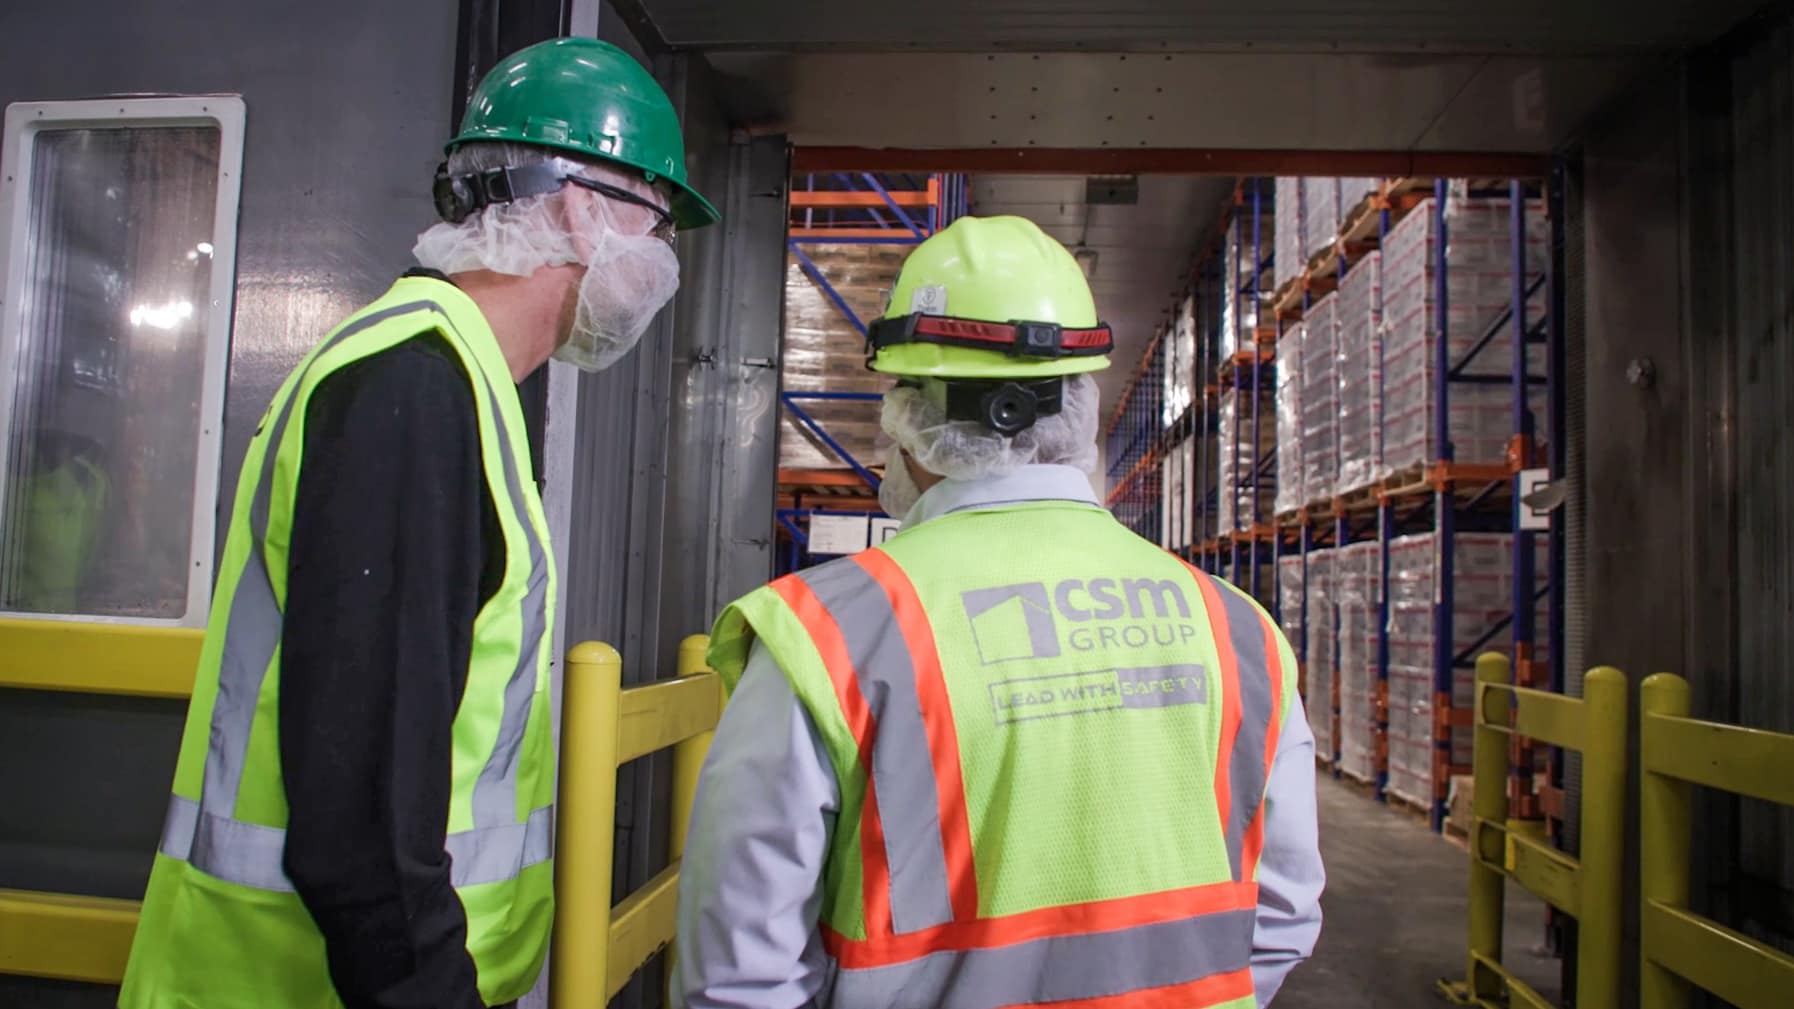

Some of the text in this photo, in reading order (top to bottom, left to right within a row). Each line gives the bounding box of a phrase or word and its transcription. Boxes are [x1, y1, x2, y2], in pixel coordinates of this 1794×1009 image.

[1054, 577, 1192, 622] csm
[1069, 624, 1196, 651] GROUP
[998, 677, 1202, 710] LEAD WITH SAFETY
